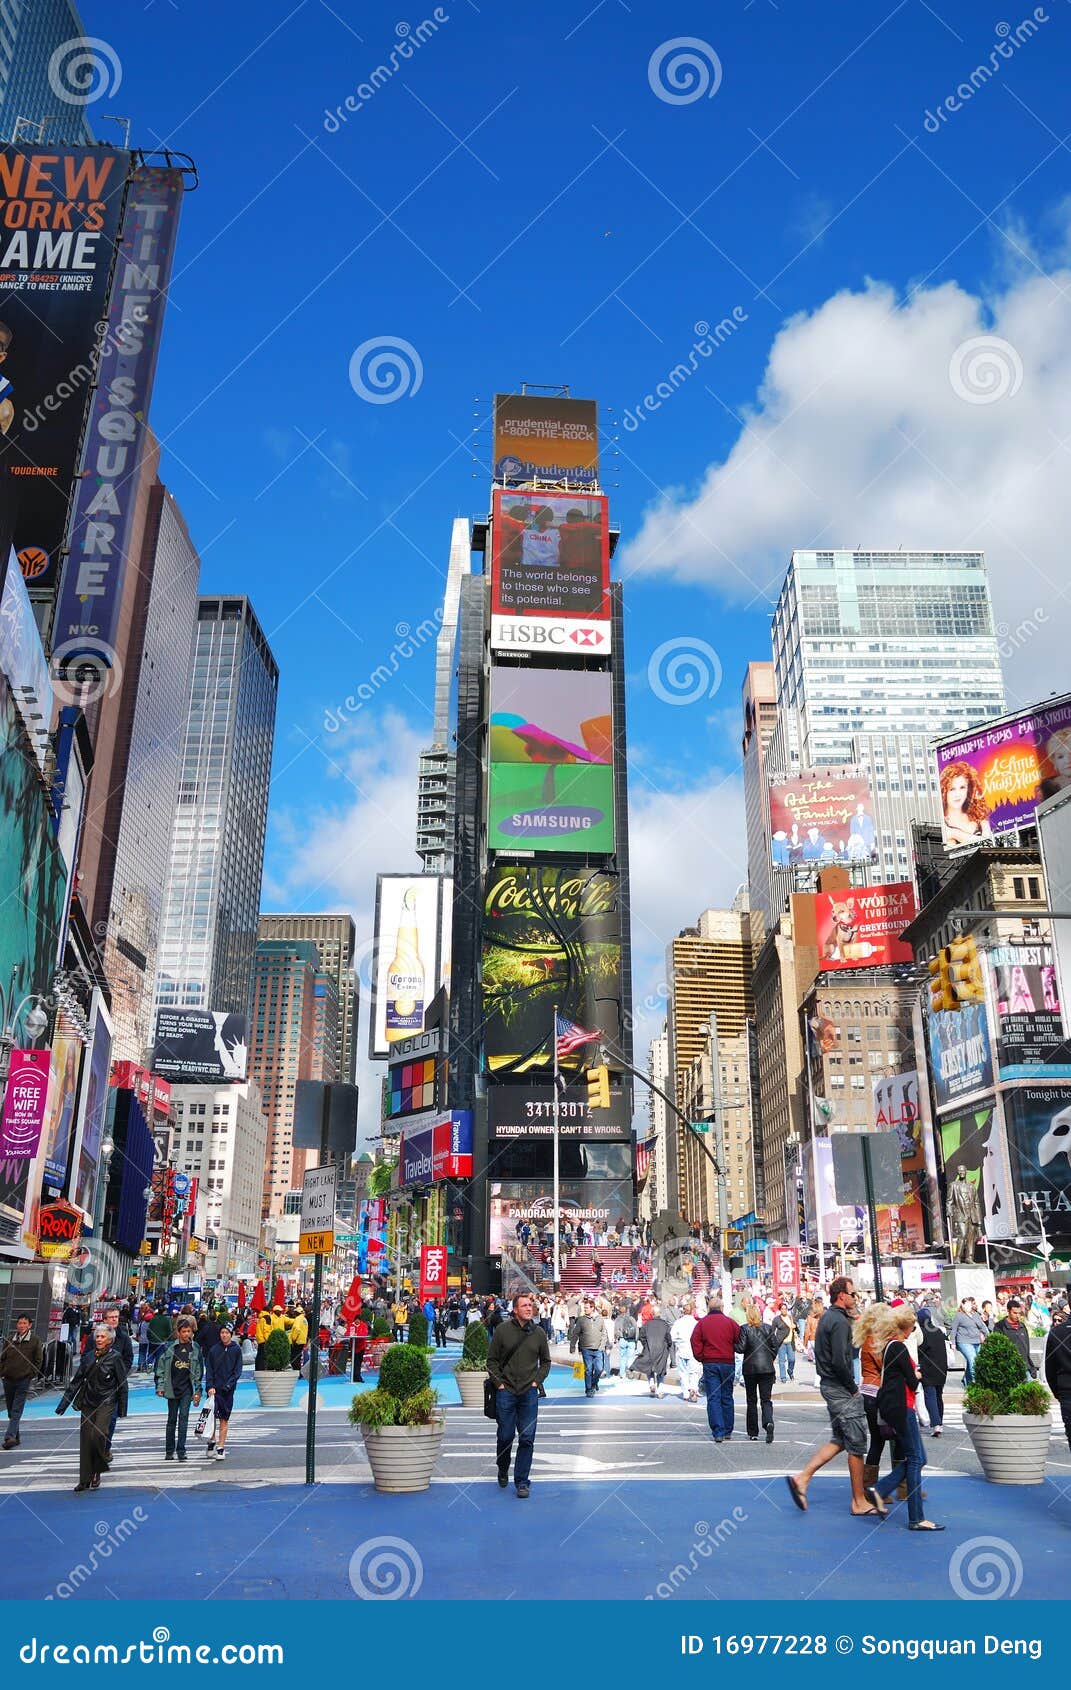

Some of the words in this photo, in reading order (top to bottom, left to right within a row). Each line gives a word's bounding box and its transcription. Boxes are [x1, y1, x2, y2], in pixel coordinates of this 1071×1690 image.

[0, 200, 106, 231] ORK'S
[0, 230, 100, 269] AME
[18, 274, 28, 282] TO
[60, 275, 93, 283] (KNICKS)
[27, 282, 36, 290] TO
[39, 282, 60, 291] MEET
[504, 418, 588, 432] prudential.com
[500, 426, 594, 441] 1-800-THE-ROCK
[526, 462, 595, 478] Prudential
[75, 376, 136, 596] SQUARE
[502, 569, 522, 579] The
[526, 570, 553, 580] world
[556, 571, 598, 585] belongs
[502, 582, 512, 591] to
[515, 582, 544, 593] those
[547, 583, 569, 594] who
[572, 586, 591, 595] see
[501, 593, 514, 603] its
[69, 624, 98, 636] NYC
[499, 624, 566, 645] HSBC
[802, 780, 834, 792] The
[784, 791, 856, 808] Addams
[512, 813, 592, 829] SAMSUNG
[791, 805, 853, 824] Family
[860, 920, 911, 933] GREYHOUND
[391, 974, 422, 985] Corona
[13, 1087, 41, 1099] FREE
[1024, 1089, 1060, 1101] Tonight
[13, 1099, 38, 1111] WIFI
[876, 1102, 921, 1127] ALD
[453, 1120, 461, 1153] Travelex
[496, 1126, 527, 1134] HYUNDAI
[561, 1126, 582, 1134] CAN'T
[584, 1126, 593, 1134] BE
[404, 1153, 432, 1180] Travelex
[304, 1176, 319, 1189] RIGHT
[321, 1174, 334, 1186] LANE
[309, 1194, 326, 1208] MUST
[509, 1208, 564, 1218] PANORAMC
[567, 1208, 610, 1218] SUNROOF
[302, 1216, 315, 1229] TURN
[316, 1215, 332, 1227] RIGHT
[307, 1236, 325, 1249] NEW
[427, 1249, 444, 1281] tkts
[779, 1250, 796, 1283] tkts
